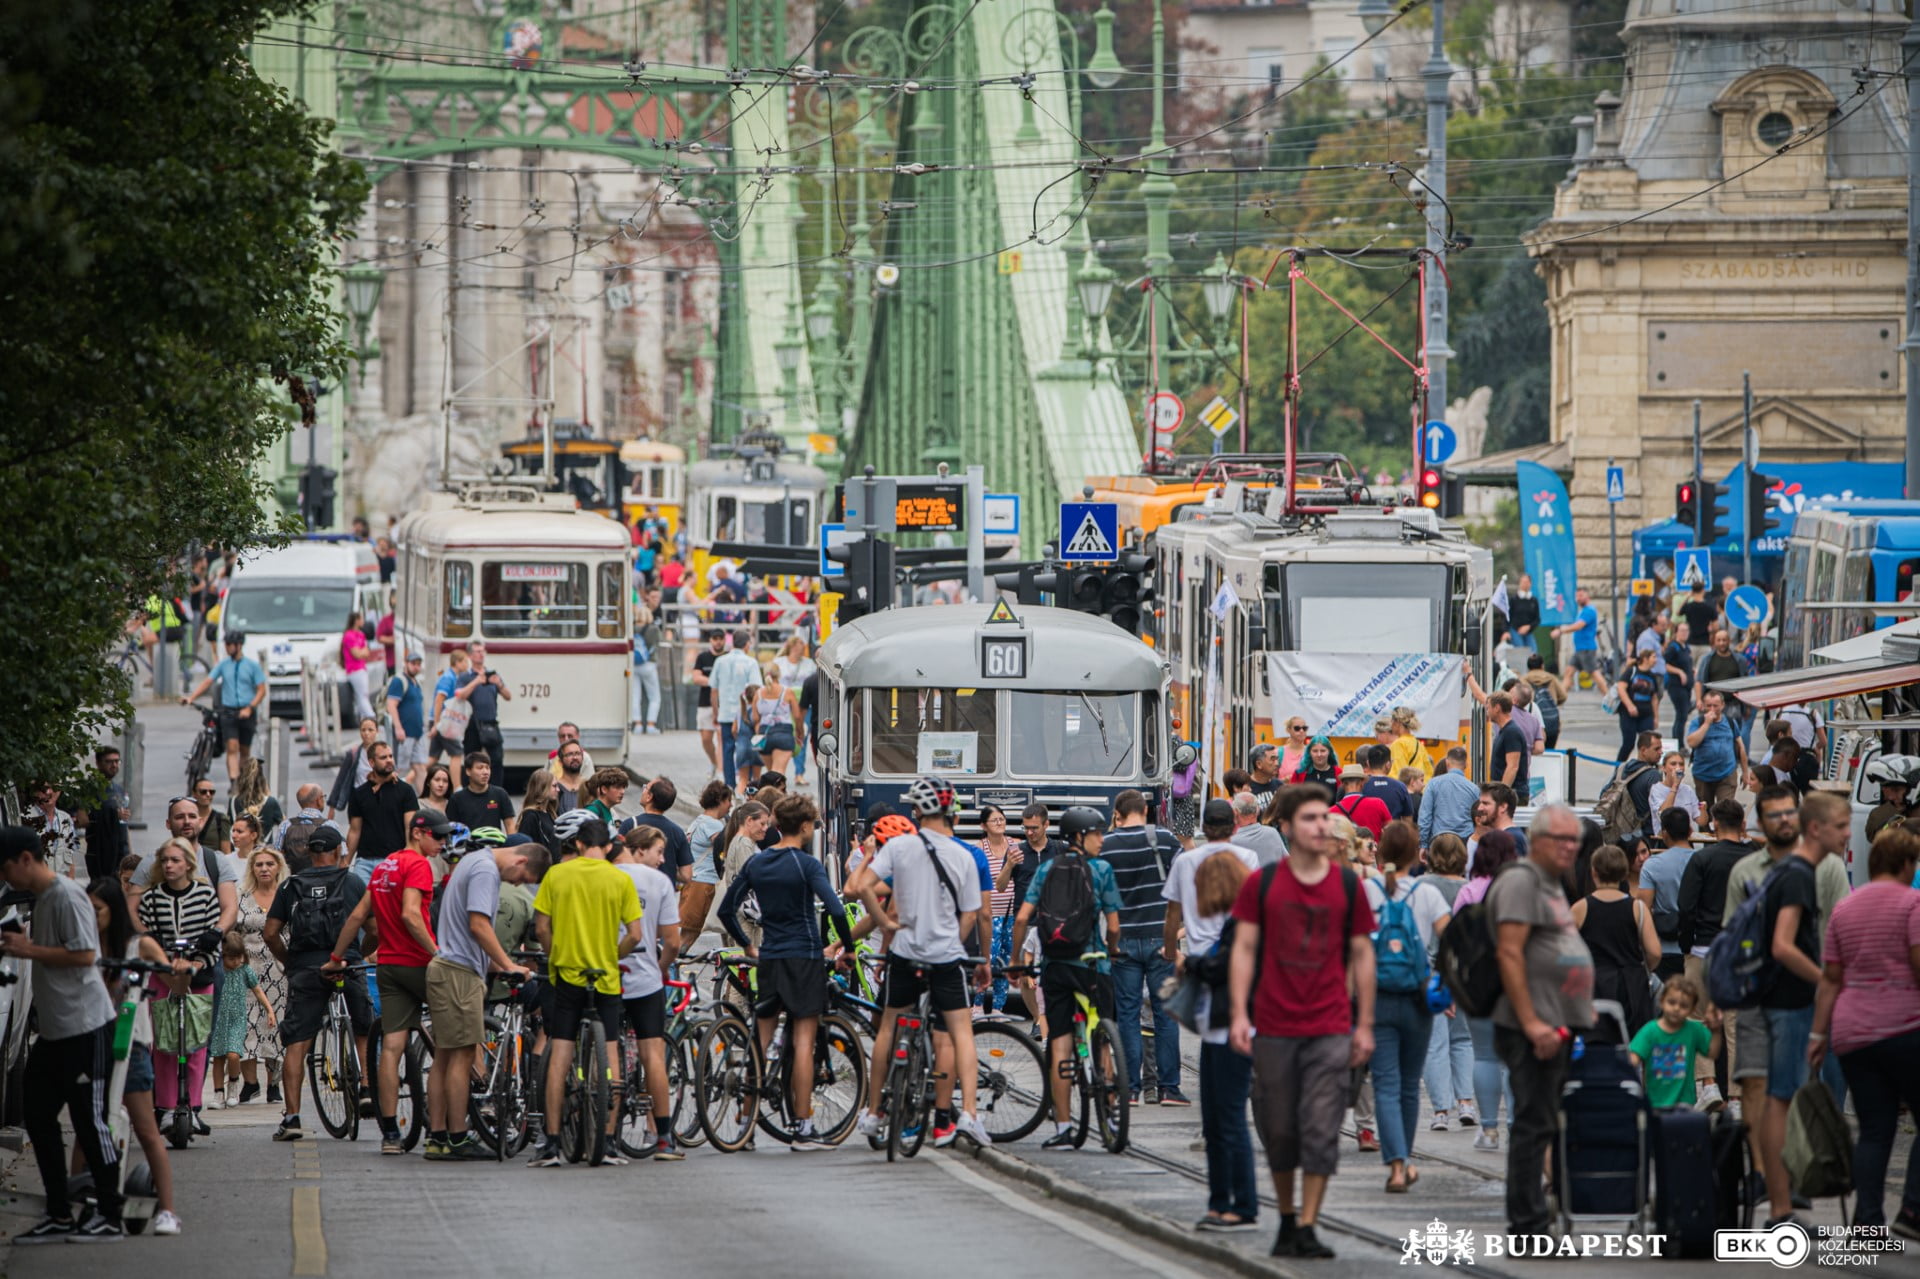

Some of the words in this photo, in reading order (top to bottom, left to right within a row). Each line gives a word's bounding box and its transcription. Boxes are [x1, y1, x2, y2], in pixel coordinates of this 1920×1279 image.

[988, 645, 1020, 675] 60
[520, 683, 551, 698] 3720
[1385, 660, 1430, 701] RELIKVIA
